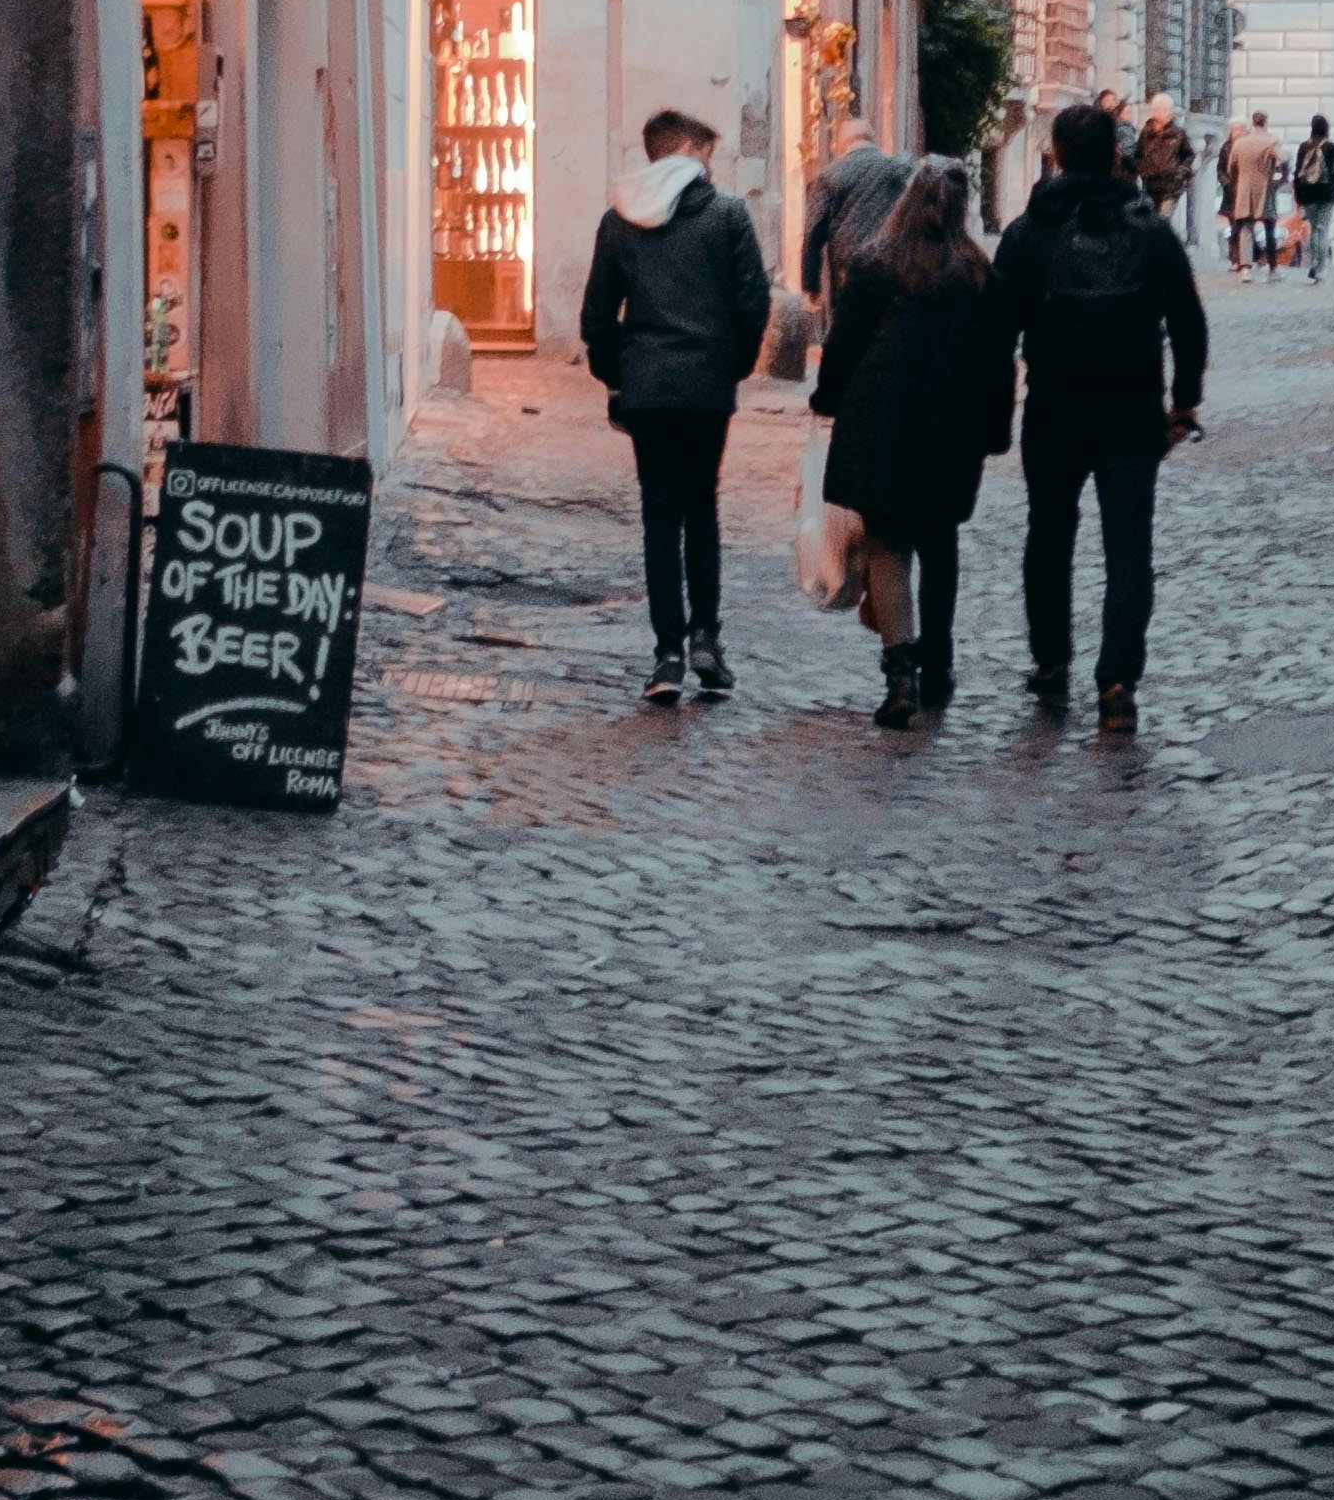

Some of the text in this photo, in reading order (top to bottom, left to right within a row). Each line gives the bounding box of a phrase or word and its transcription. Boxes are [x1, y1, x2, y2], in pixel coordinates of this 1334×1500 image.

[176, 500, 322, 567] SOUP
[162, 559, 213, 604] OF
[213, 562, 281, 611] THE
[232, 742, 340, 768] OFF LICENSE
[285, 769, 339, 799] ROMA
